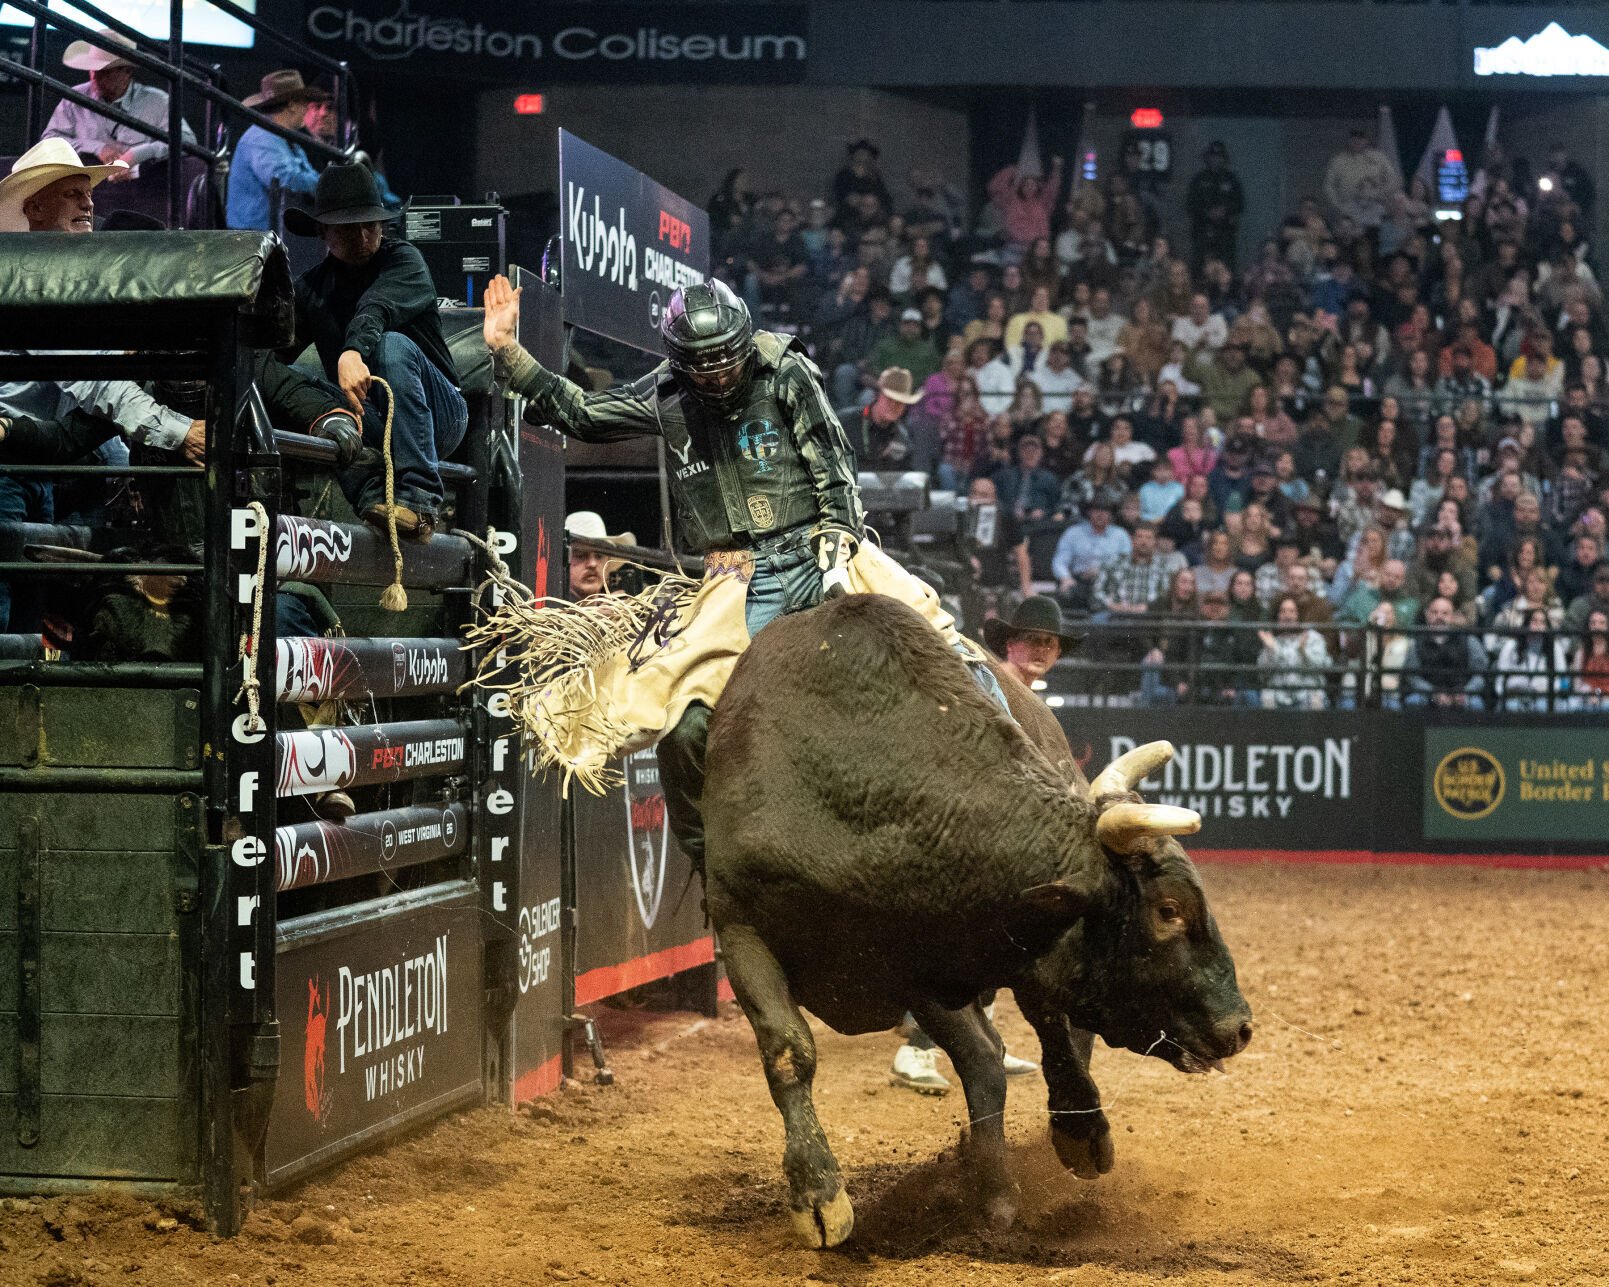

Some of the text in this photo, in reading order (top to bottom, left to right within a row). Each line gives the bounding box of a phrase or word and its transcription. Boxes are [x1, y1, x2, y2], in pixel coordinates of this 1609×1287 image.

[308, 6, 807, 60] Charleston Coliseum
[569, 181, 638, 291] Kubota
[408, 647, 449, 686] Kubota
[405, 738, 464, 767] CHARLESTON
[1520, 758, 1595, 781] United
[1520, 781, 1595, 801] Border
[385, 834, 393, 848] 20
[398, 828, 415, 846] WEST
[416, 823, 442, 842] VIRGINIA
[532, 946, 551, 987] SHOP
[336, 934, 448, 1074] PENDLETON
[365, 1045, 424, 1102] WHISKY
